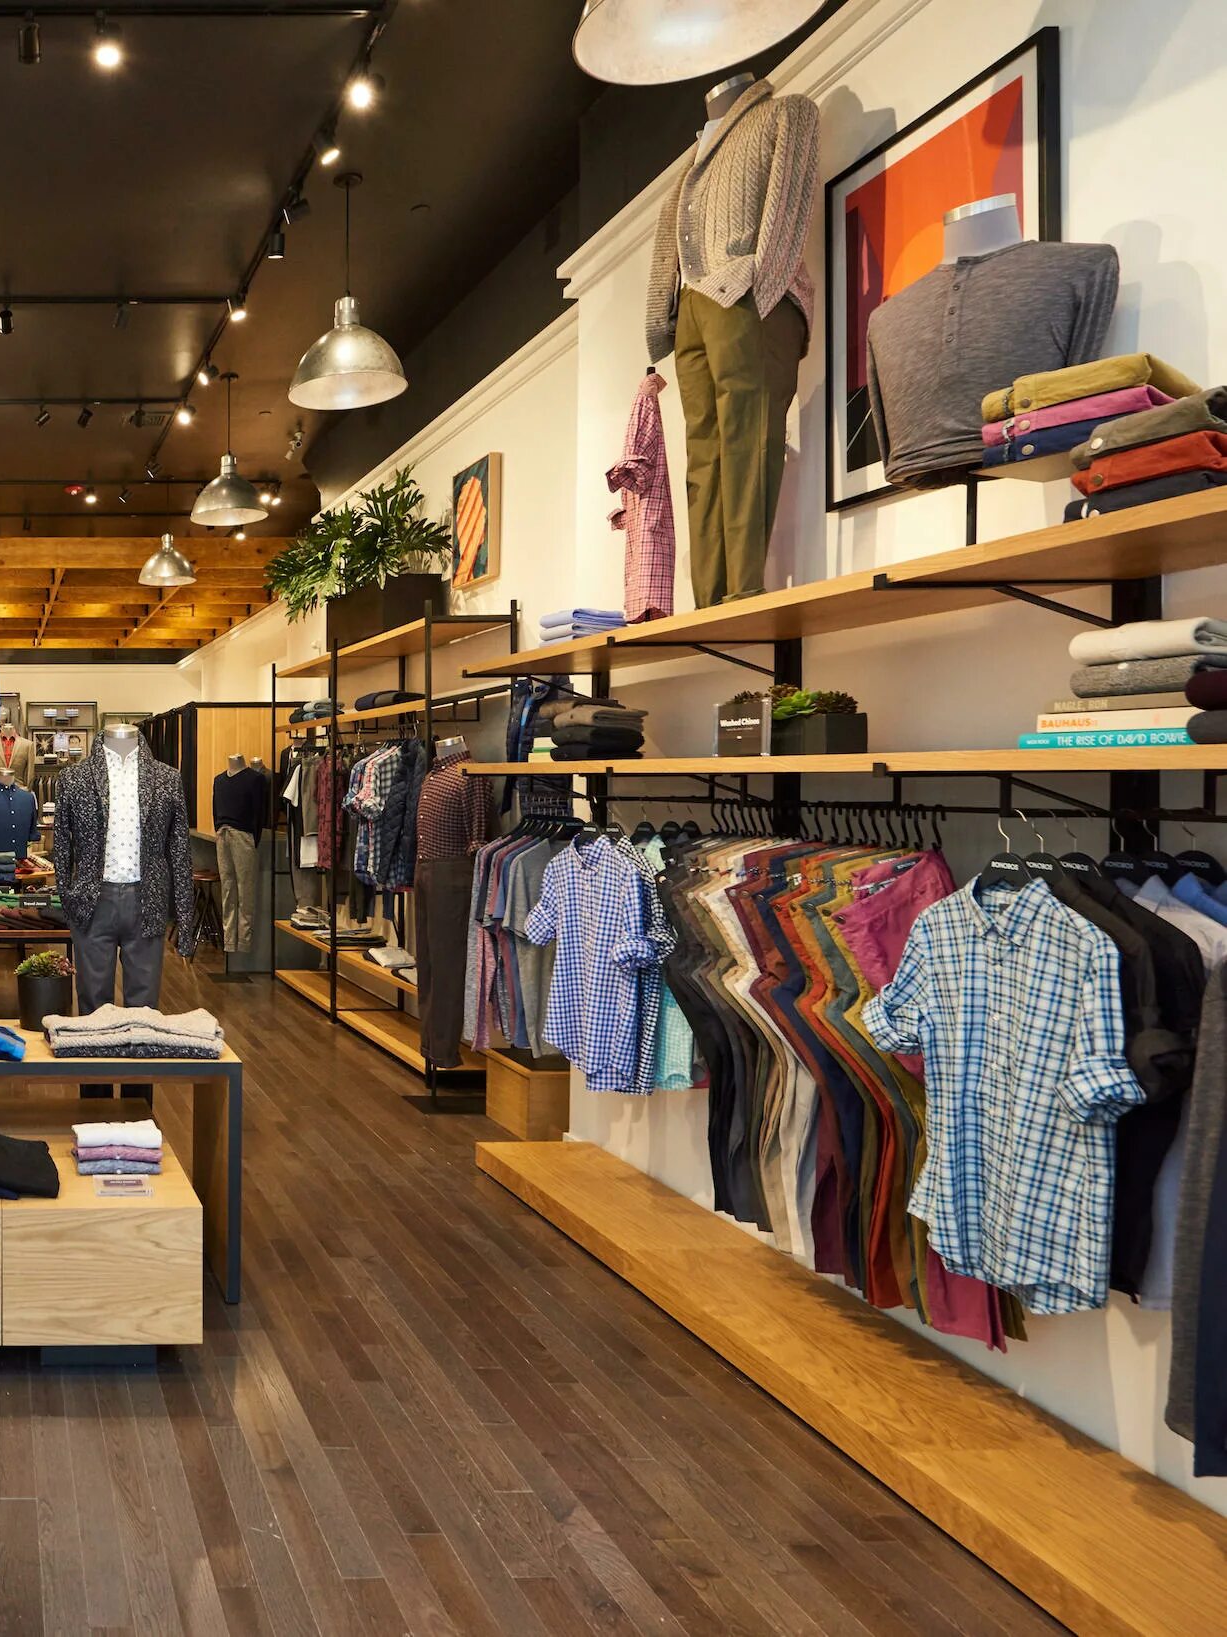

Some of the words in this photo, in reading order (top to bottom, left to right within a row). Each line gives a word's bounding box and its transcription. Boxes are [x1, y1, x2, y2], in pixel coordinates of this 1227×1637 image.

[1041, 719, 1092, 728] BAUHAUS
[1057, 736, 1074, 746] THE
[1076, 735, 1096, 746] RISE
[1098, 735, 1114, 745] OF
[1150, 733, 1187, 744] BOWIE
